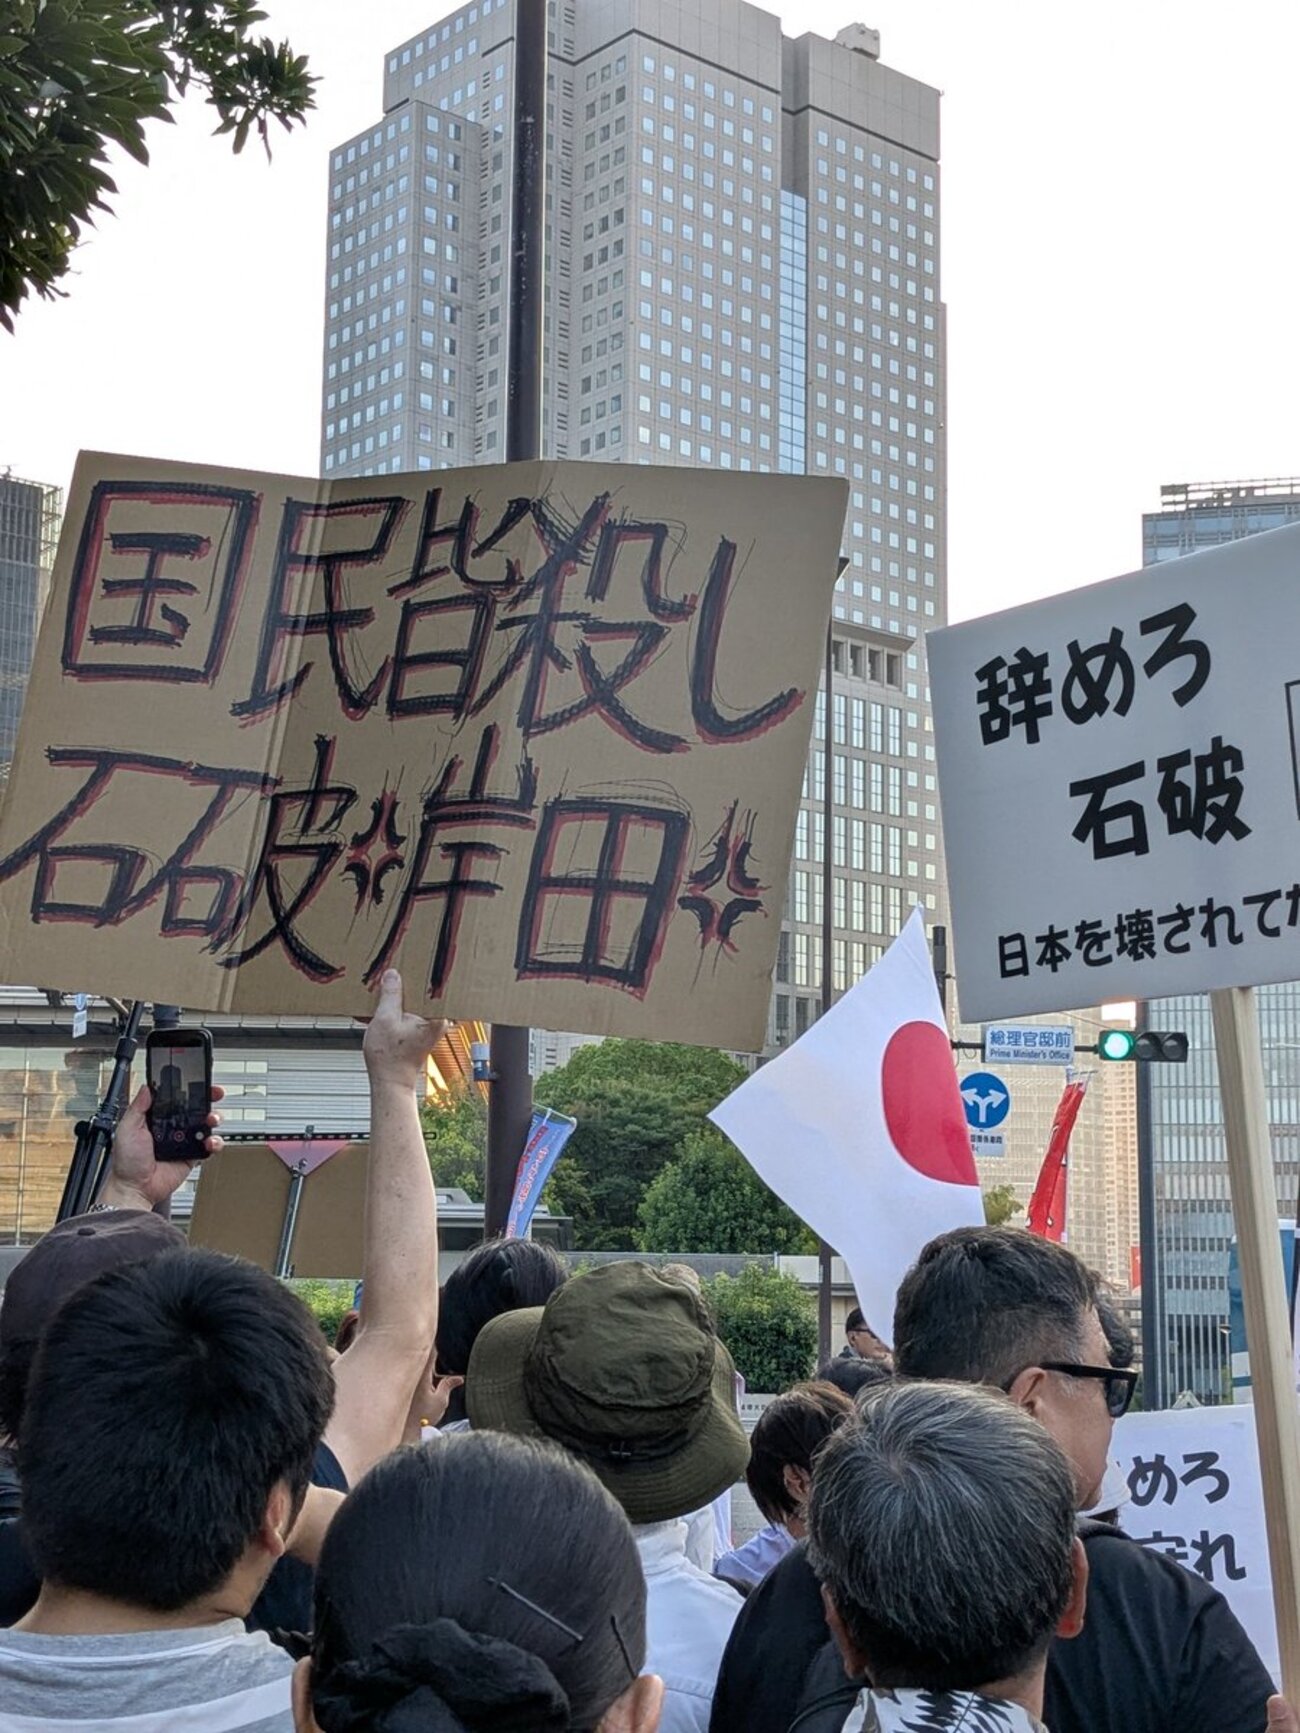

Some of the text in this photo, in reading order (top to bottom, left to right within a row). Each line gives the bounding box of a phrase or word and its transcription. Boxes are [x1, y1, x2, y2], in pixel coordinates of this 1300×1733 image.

[975, 603, 1211, 746] 辞めろ
[1070, 736, 1252, 861] 石破
[990, 1030, 1071, 1047] 総理官邸前
[990, 1048, 1070, 1060] Prime Minister's Office
